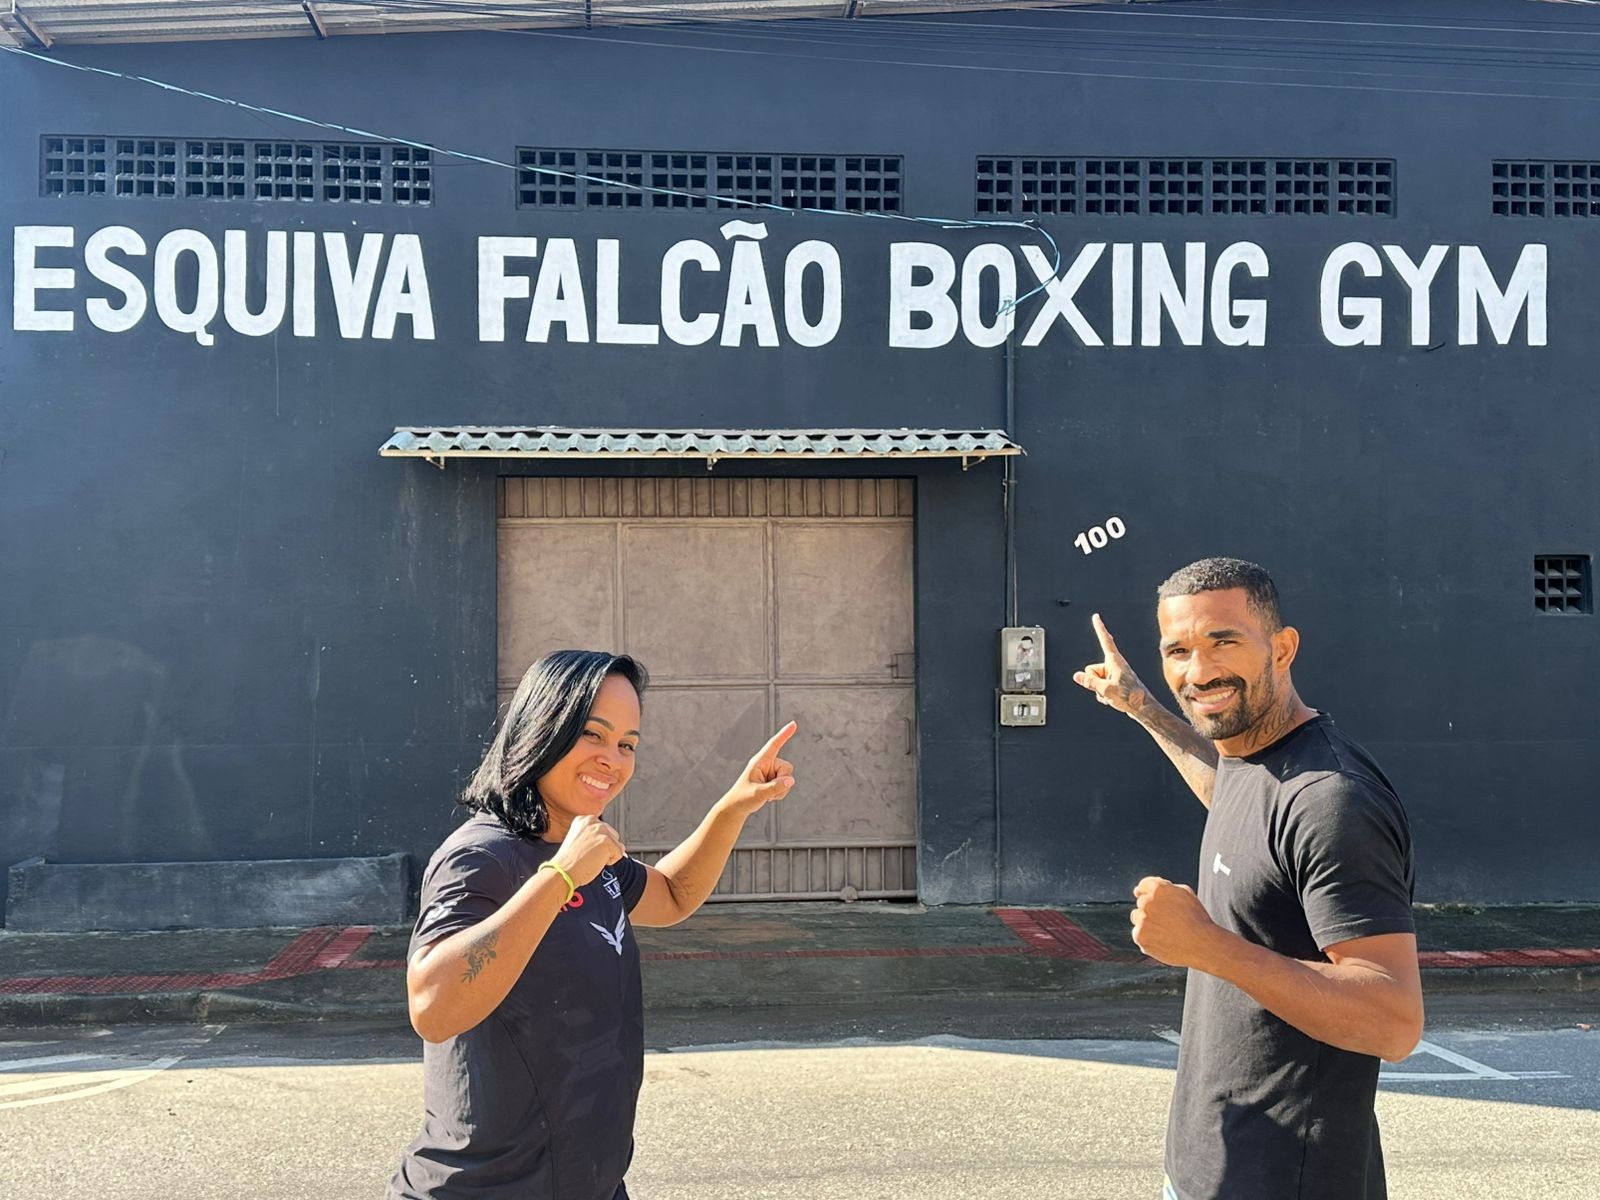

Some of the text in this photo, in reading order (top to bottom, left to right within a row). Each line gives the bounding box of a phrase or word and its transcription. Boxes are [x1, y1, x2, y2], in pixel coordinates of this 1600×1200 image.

[13, 219, 1549, 349] ESQUIVA FALCÃO BOXING GYM
[1073, 516, 1127, 555] 100
